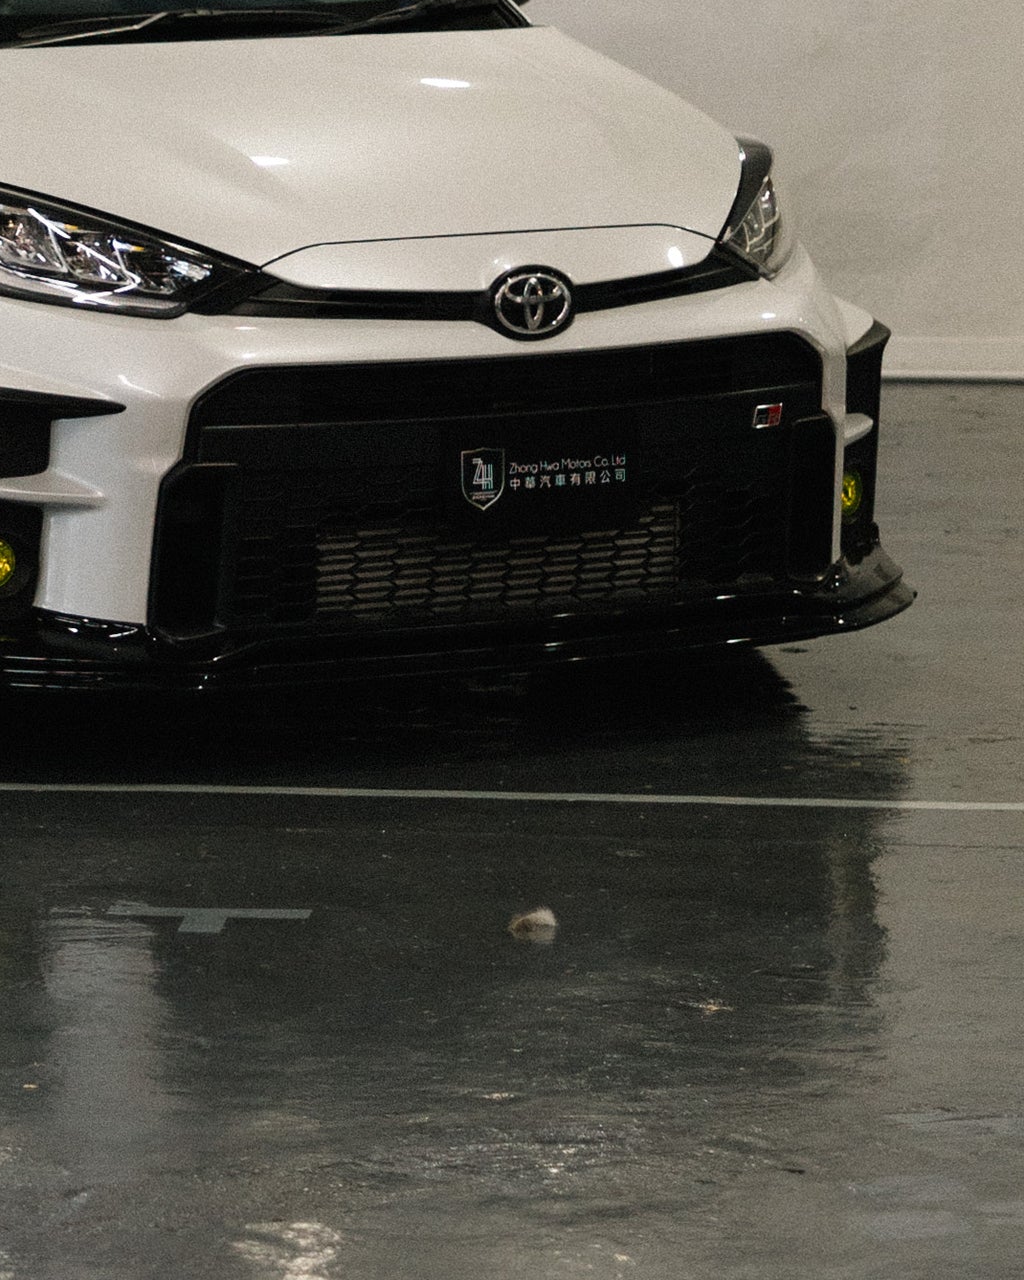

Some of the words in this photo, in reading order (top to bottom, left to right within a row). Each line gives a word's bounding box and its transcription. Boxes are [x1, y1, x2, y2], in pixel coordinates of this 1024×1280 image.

[509, 462, 538, 475] Zhong
[539, 460, 560, 472] Hwa
[561, 457, 592, 470] Motors
[611, 454, 626, 467] Ltd
[509, 468, 626, 491] 中華汽車有限公司
